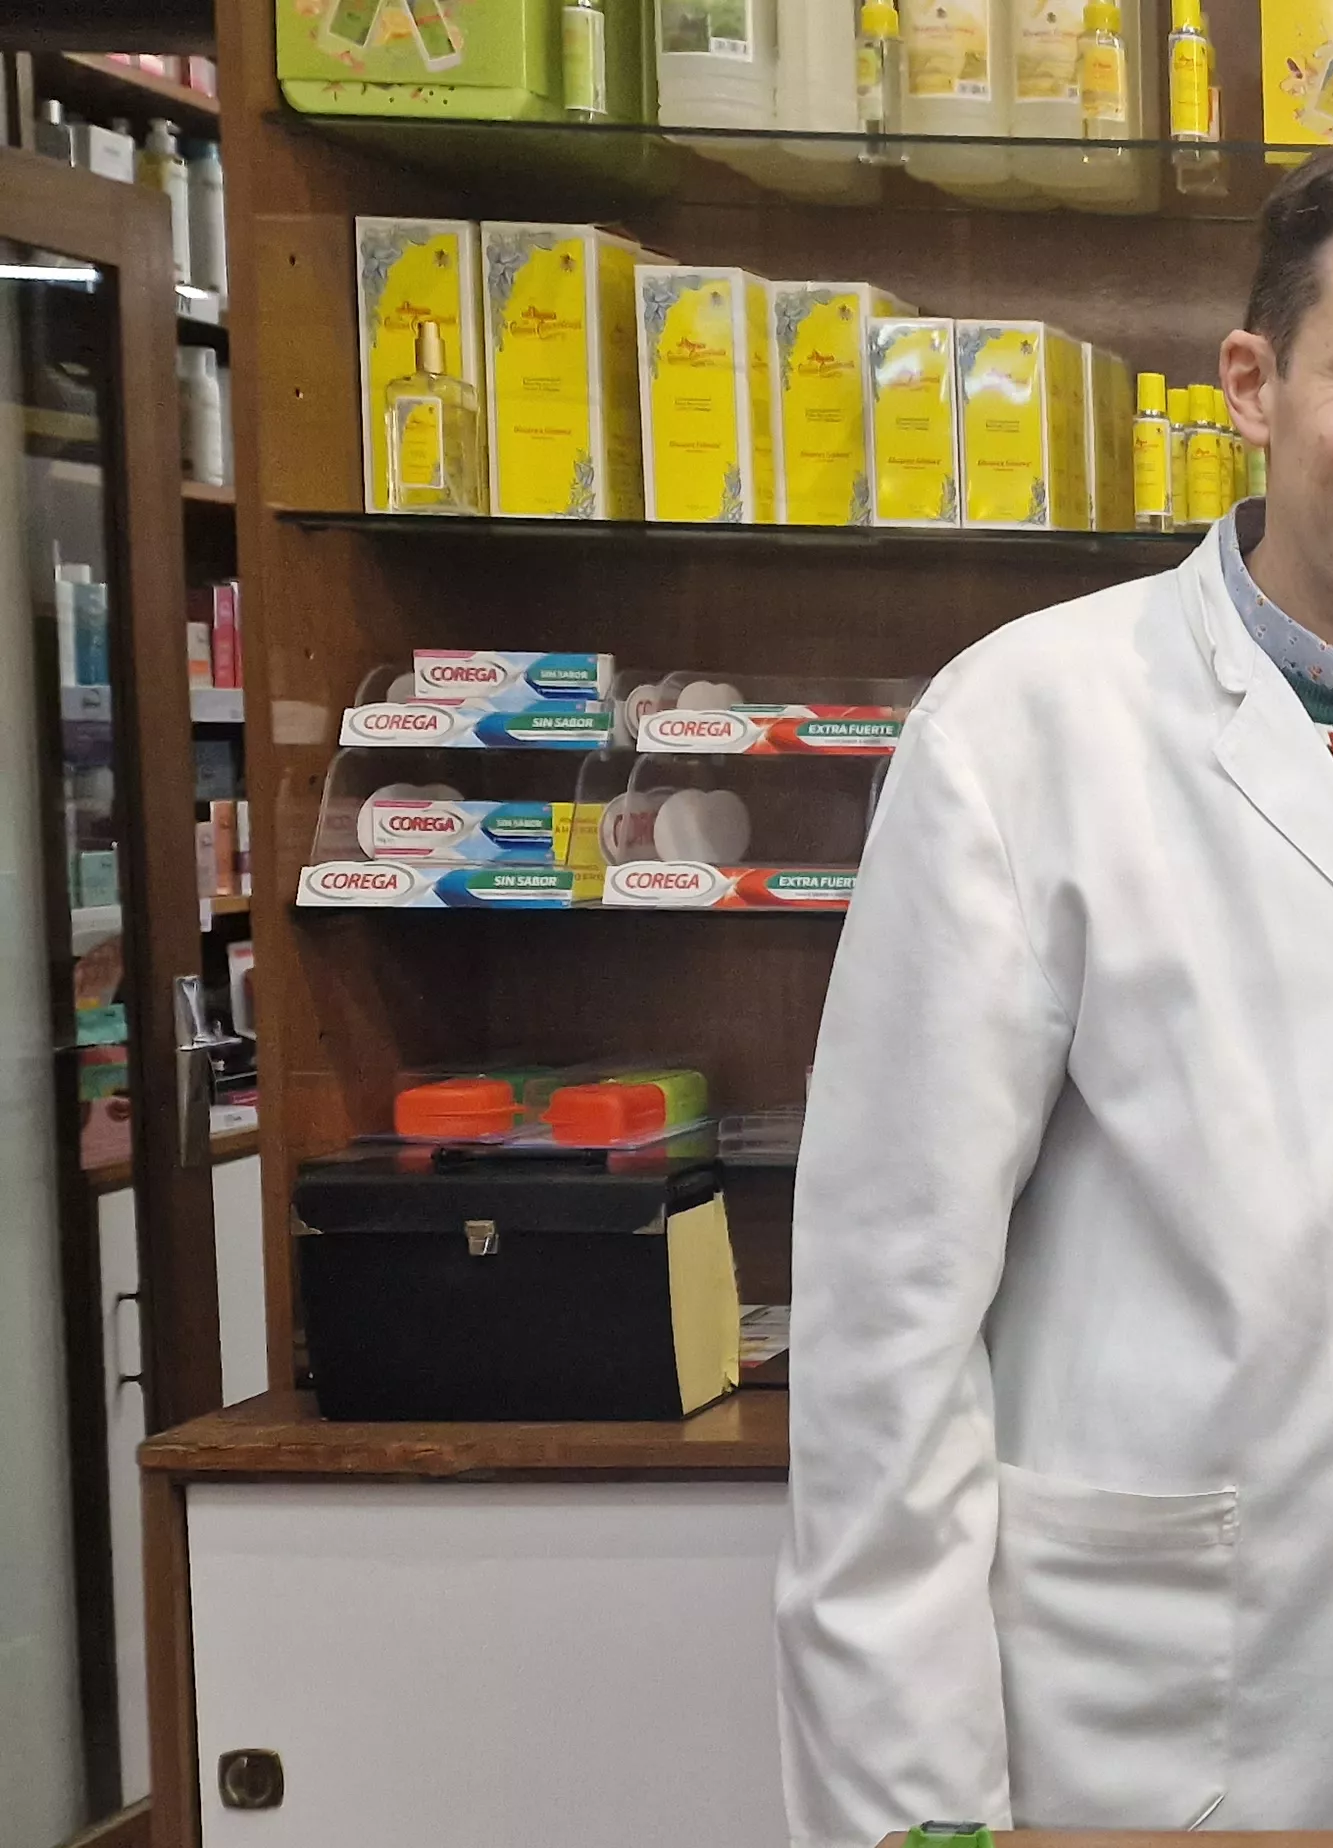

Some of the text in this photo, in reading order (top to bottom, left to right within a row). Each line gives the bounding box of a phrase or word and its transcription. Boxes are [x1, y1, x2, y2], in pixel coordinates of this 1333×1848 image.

[430, 666, 498, 683] COREGA
[363, 714, 438, 731] COREGA
[532, 717, 594, 729] SIN SABOR
[659, 720, 732, 738] COREGA
[808, 724, 894, 736] EXTRA FUERTE
[388, 815, 456, 832] COREGA
[320, 873, 398, 890] COREGA
[494, 875, 558, 887] SIN SABOR
[625, 873, 700, 890] COREGA
[779, 876, 857, 889] EXTRA FUERT
